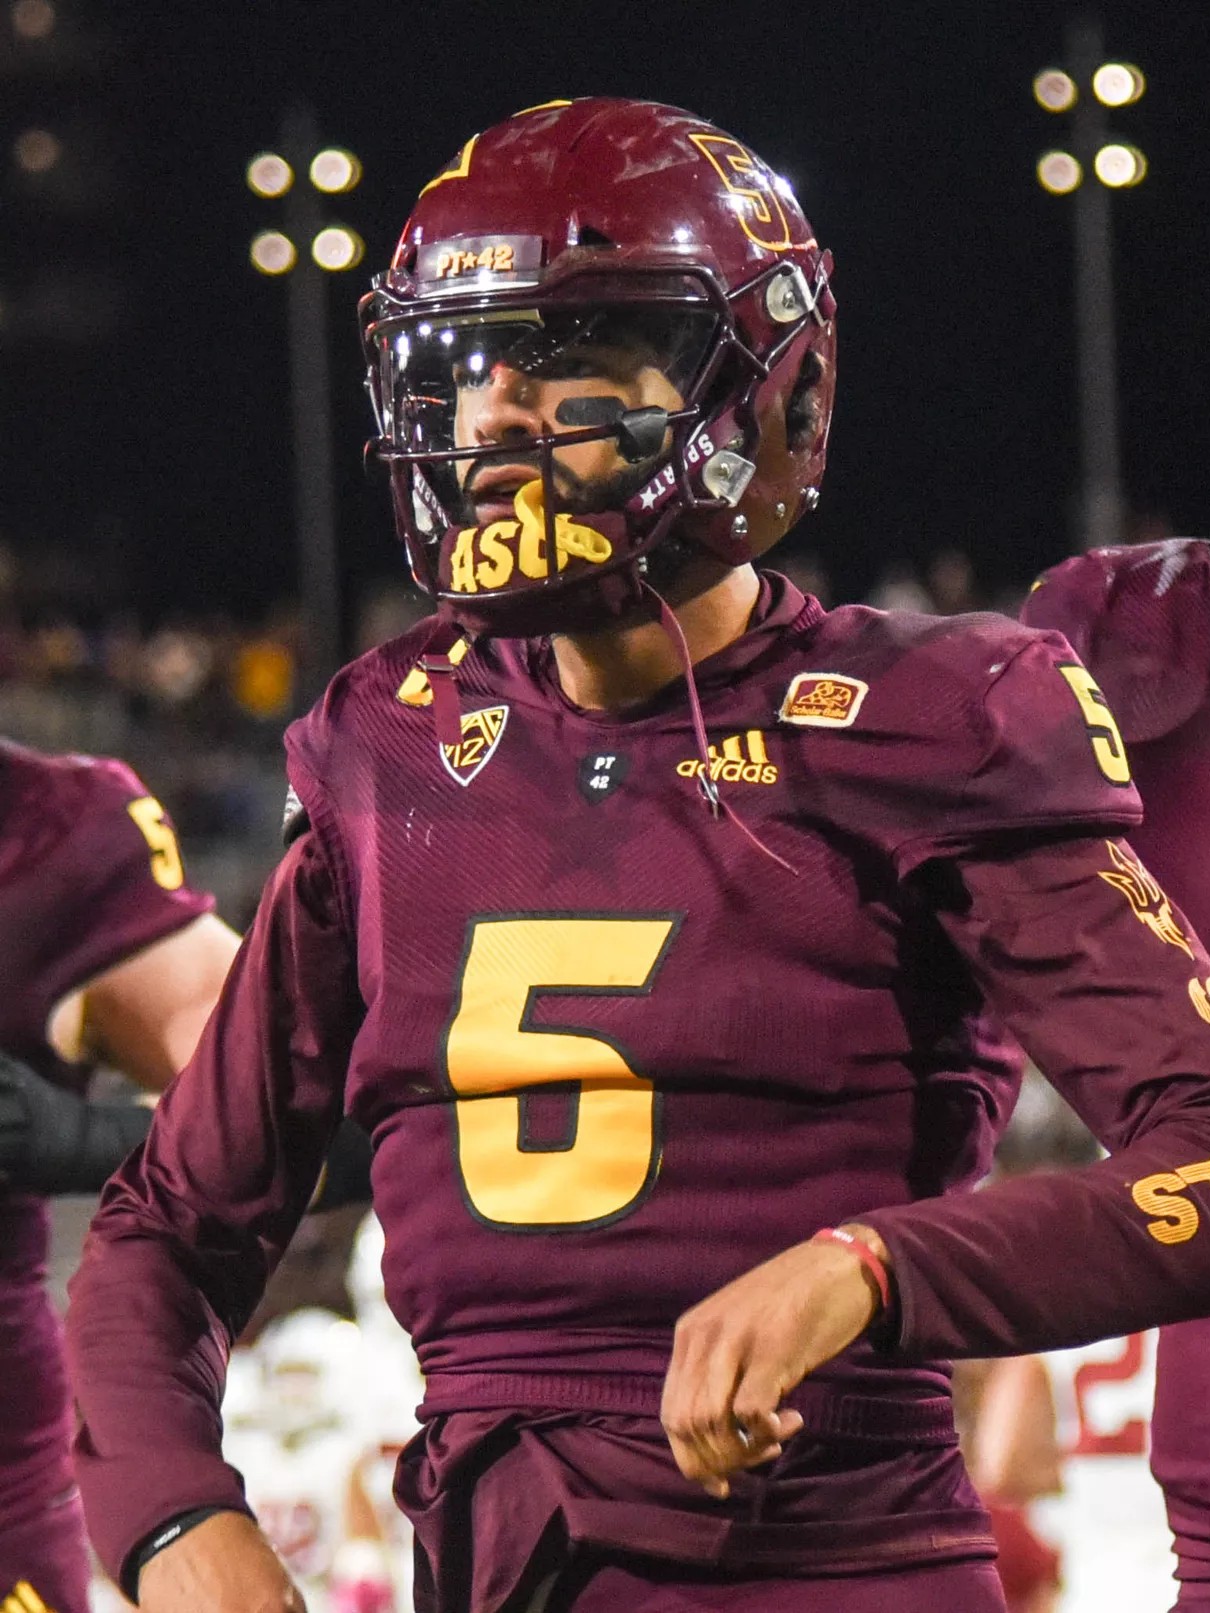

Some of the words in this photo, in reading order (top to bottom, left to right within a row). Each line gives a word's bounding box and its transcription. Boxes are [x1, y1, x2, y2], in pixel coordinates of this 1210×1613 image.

[688, 134, 792, 252] 5
[654, 433, 715, 497] SPRT
[1055, 661, 1132, 788] 5
[589, 775, 610, 790] 42
[594, 756, 616, 770] PT
[676, 757, 778, 784] adidas
[126, 797, 183, 890] 5
